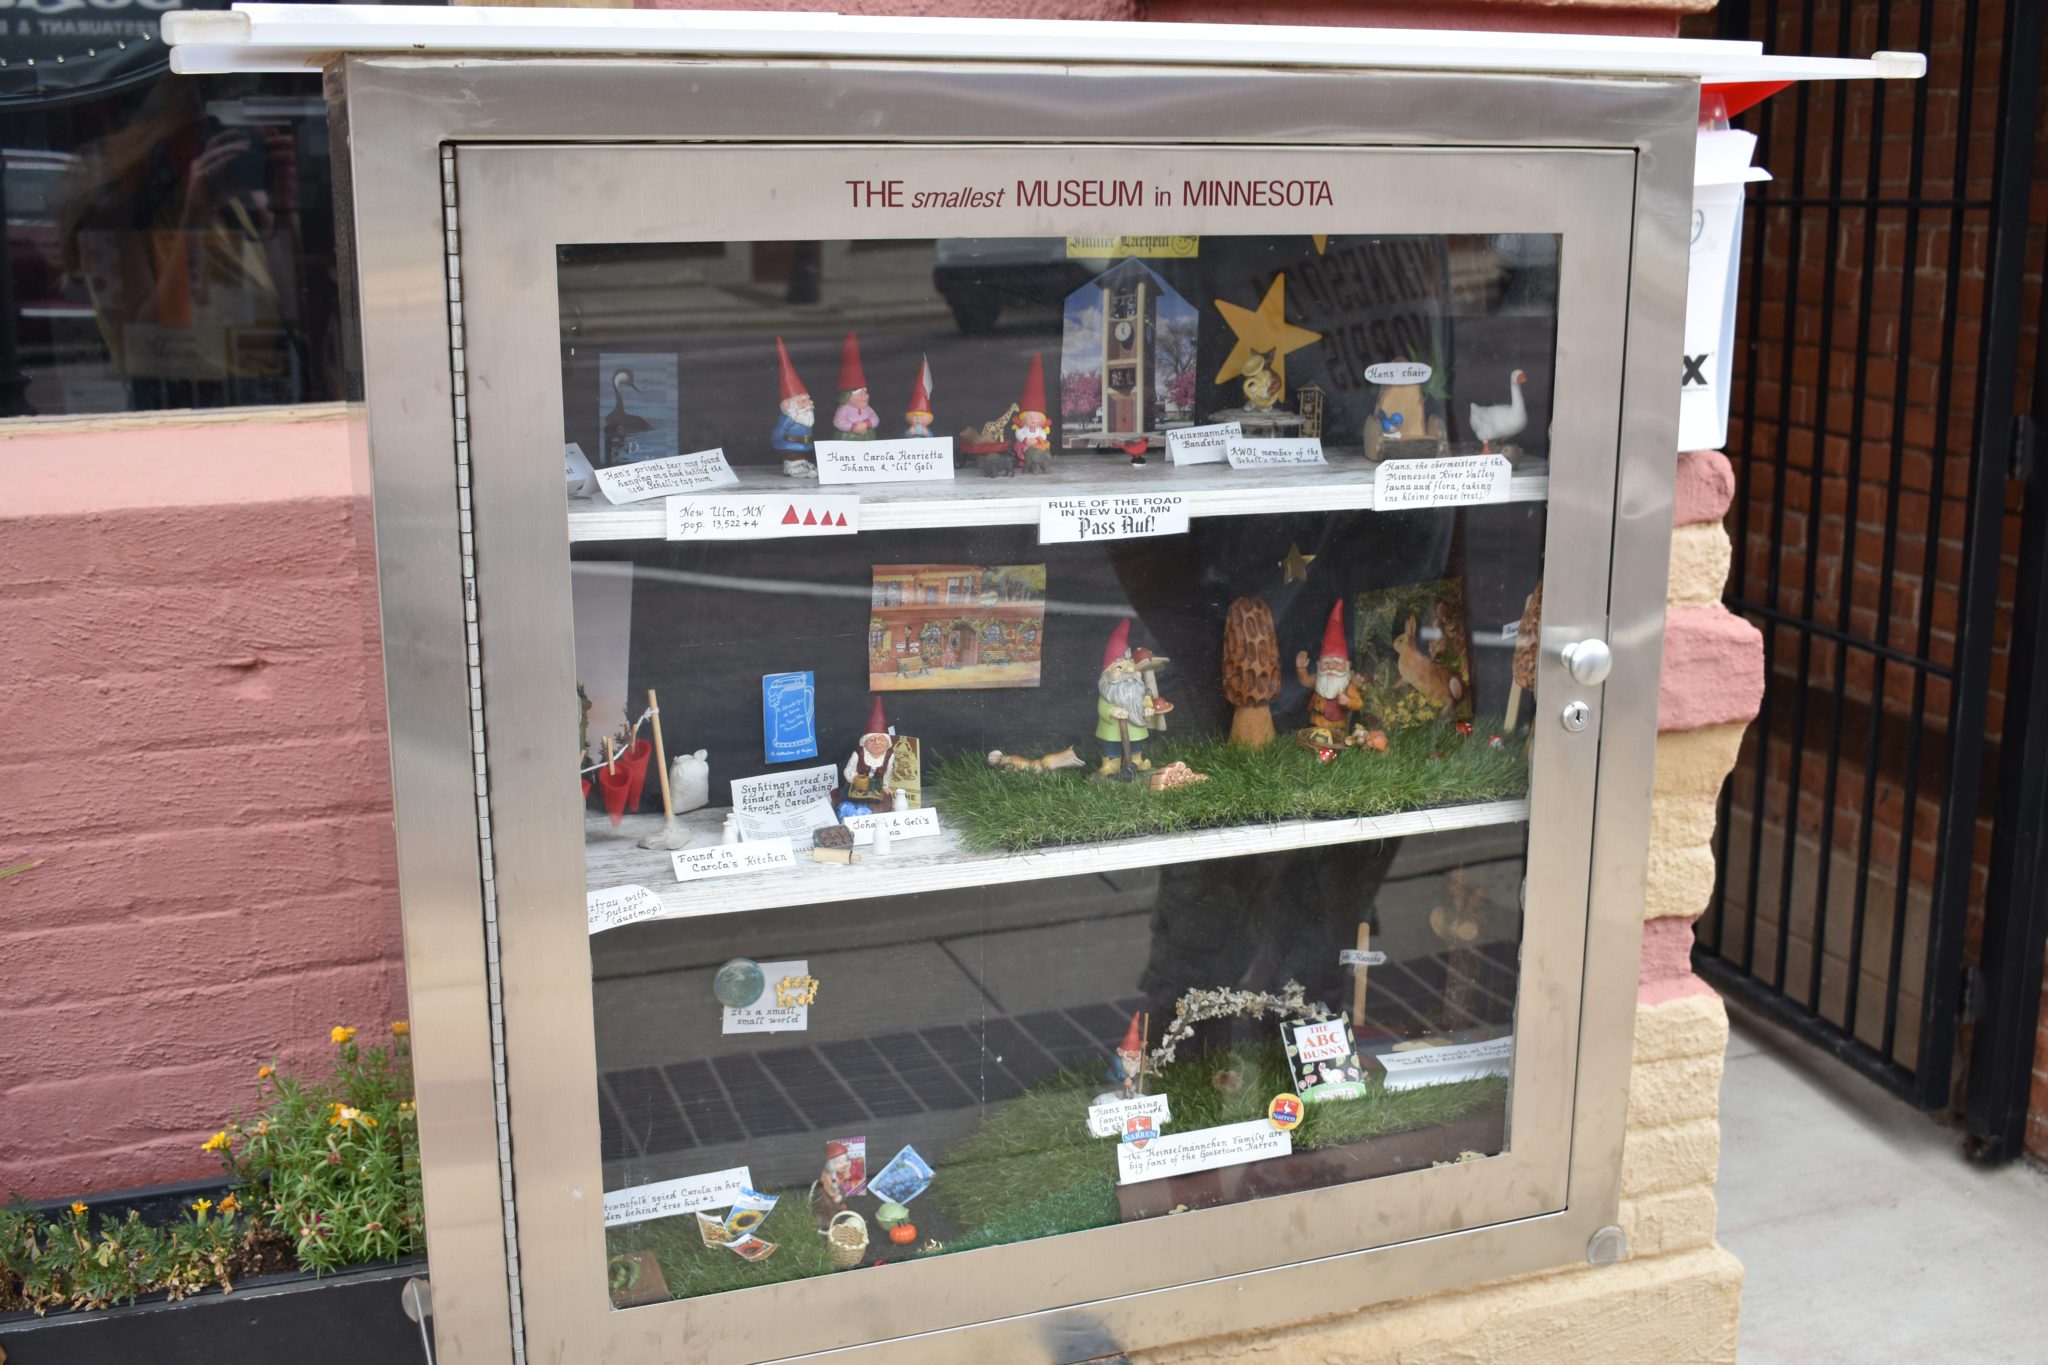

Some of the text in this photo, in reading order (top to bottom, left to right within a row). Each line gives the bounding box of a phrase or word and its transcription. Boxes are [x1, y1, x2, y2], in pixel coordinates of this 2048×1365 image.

[846, 180, 1334, 209] THE smallest MUSEUM in MINNESOTA
[1402, 366, 1427, 377] chair
[827, 450, 944, 462] Hans Carola Henrietta
[1261, 448, 1292, 457] member
[1295, 447, 1304, 458] of
[1306, 446, 1319, 456] the
[604, 469, 631, 481] Han's
[634, 463, 665, 478] private
[666, 461, 683, 471] beer
[700, 452, 721, 468] found
[839, 463, 876, 472] Johann
[880, 464, 889, 472] &
[914, 461, 934, 474] Geli
[1415, 459, 1429, 469] the
[1431, 458, 1478, 469] obermeister
[1480, 457, 1489, 468] of
[1490, 456, 1504, 466] the
[617, 474, 652, 488] hanging
[668, 468, 685, 479] hook
[685, 465, 710, 477] behind
[711, 464, 723, 474] the
[648, 477, 680, 491] Schell's
[681, 475, 694, 487] tap
[1385, 469, 1496, 482] Minnesota River Valley
[1384, 480, 1492, 496] fauna and flora, taking
[1049, 496, 1182, 509] RULE OF THE ROAD
[1402, 491, 1430, 502] kleine
[1431, 492, 1458, 505] pause
[679, 501, 767, 519] New Ulm, MN
[1061, 505, 1171, 517] IN NEW ULM, MN
[680, 521, 706, 535] pop.
[712, 519, 741, 531] 13,522
[1078, 514, 1156, 540] Pass Auf!
[741, 772, 836, 797] Sightings noted by
[742, 783, 834, 805] kinder kids looking
[742, 801, 780, 814] through
[893, 818, 901, 827] &
[904, 817, 930, 827] Geli's
[677, 848, 734, 863] Found in
[692, 853, 788, 873] Carola's Kitchen
[625, 888, 648, 903] with
[612, 903, 662, 925] (dustmop)
[731, 1007, 751, 1016] It's
[737, 1013, 801, 1025] small world
[1310, 1025, 1328, 1034] THE
[1303, 1031, 1341, 1049] ABC
[1303, 1044, 1346, 1060] BUNNY
[1094, 1101, 1159, 1117] Hans making
[1273, 1111, 1297, 1123] Narren
[1124, 1130, 1157, 1141] NARREN
[1123, 1152, 1142, 1161] The
[1232, 1132, 1266, 1145] Family
[1268, 1130, 1284, 1139] are
[1128, 1140, 1279, 1175] big fans of the Goosetown Narren
[604, 1180, 743, 1211] townsfolk spied Carola in her
[625, 1204, 659, 1218] behind
[662, 1200, 682, 1211] tree
[684, 1197, 701, 1207] hut
